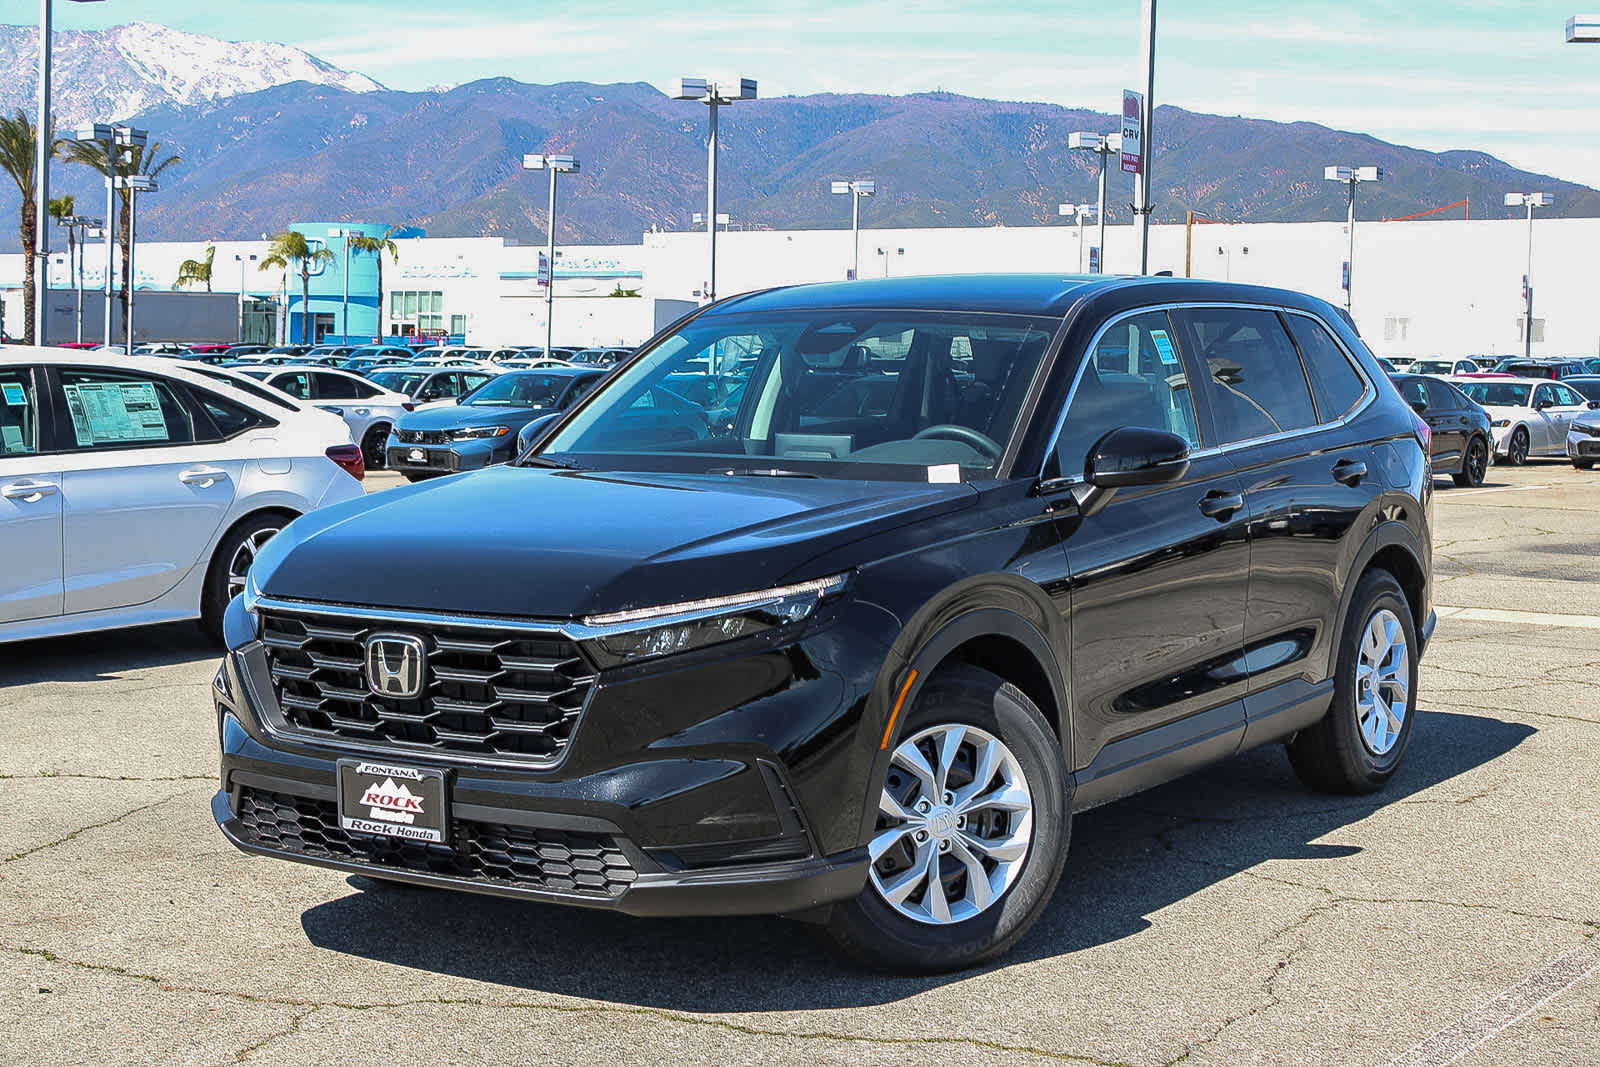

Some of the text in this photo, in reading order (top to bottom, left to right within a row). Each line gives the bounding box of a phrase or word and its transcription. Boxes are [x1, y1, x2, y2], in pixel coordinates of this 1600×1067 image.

[1123, 128, 1139, 140] CRV
[364, 765, 417, 778] FONTANA
[366, 793, 418, 809] ROCK
[396, 827, 434, 840] Honda
